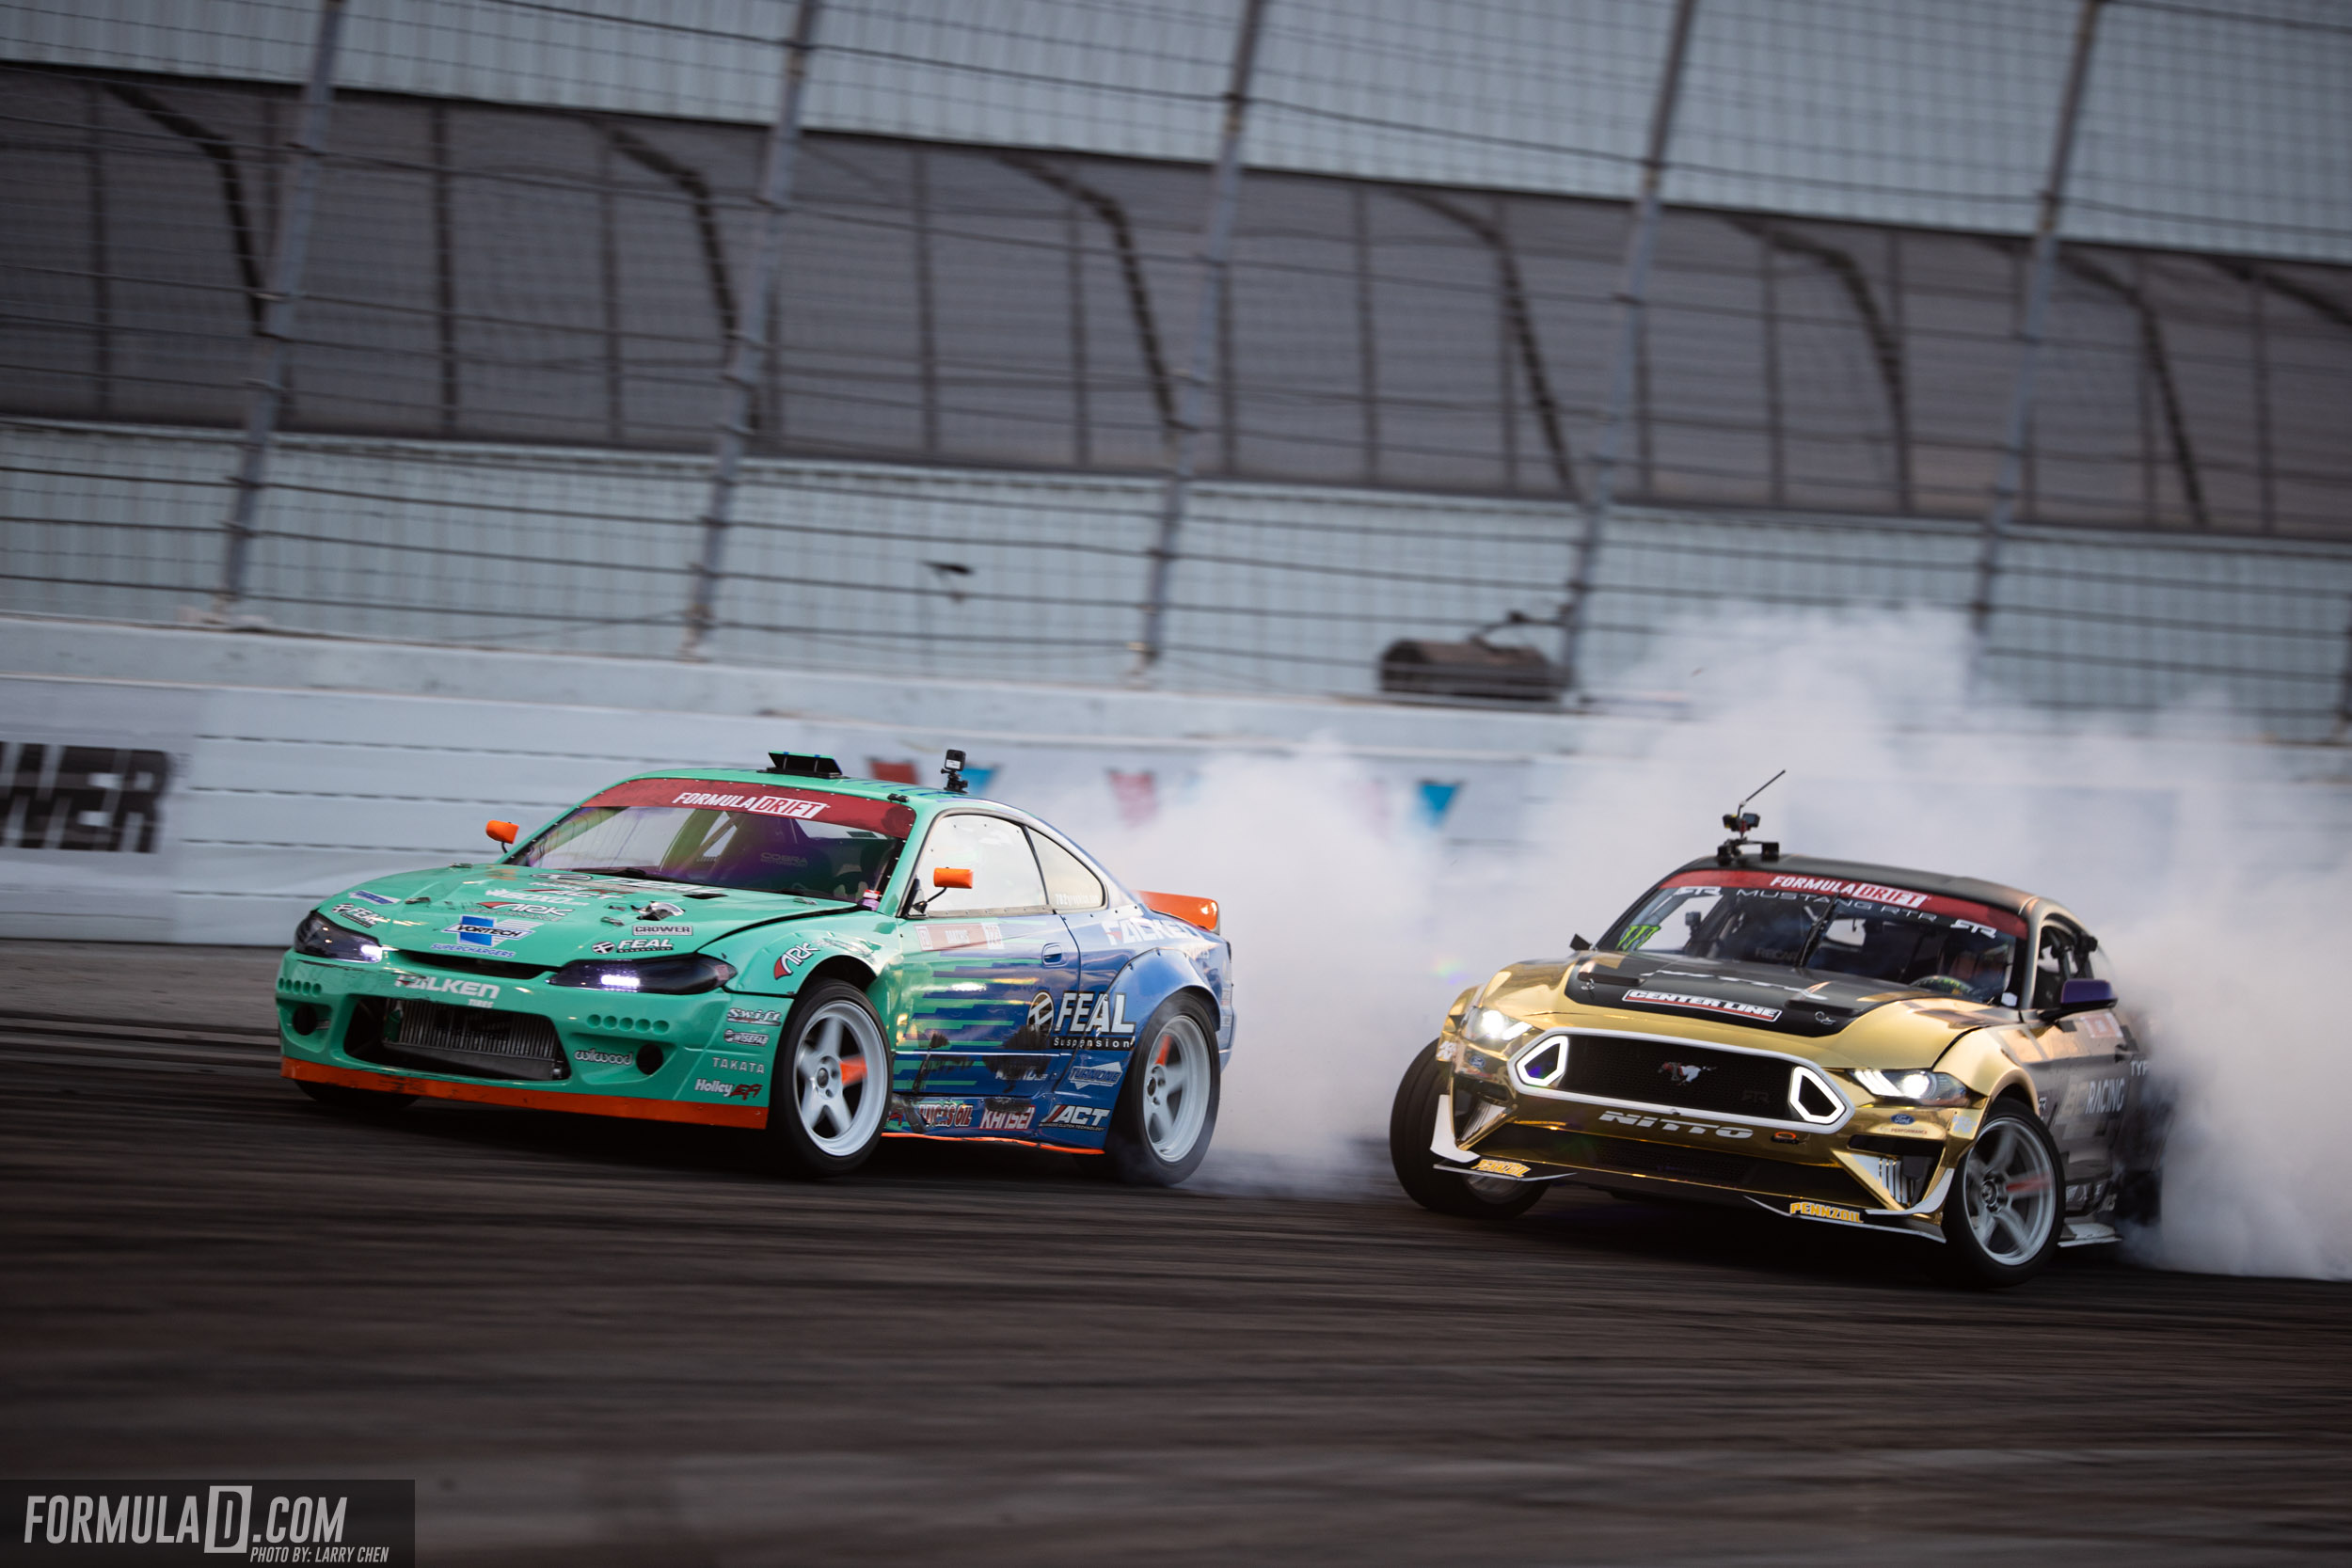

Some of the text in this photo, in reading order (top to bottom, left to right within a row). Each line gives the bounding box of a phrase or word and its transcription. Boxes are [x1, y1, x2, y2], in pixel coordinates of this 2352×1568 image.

[1736, 889, 1937, 923] MUSTANG RTR
[457, 925, 523, 938] VORTECH
[431, 943, 516, 958] SUPERCHARGERS
[617, 939, 674, 949] FEAL
[394, 974, 501, 999] FALKEN
[1054, 991, 1136, 1033] FEAL
[1629, 990, 1780, 1017] CENTER LINE
[727, 1008, 782, 1022] Swift
[1054, 1037, 1131, 1049] Suspension
[574, 1047, 633, 1066] wilwood
[712, 1057, 765, 1073] TAKATA
[694, 1078, 734, 1097] Holley
[2085, 1078, 2125, 1114] RACING
[919, 1103, 955, 1127] LUCAS
[955, 1103, 974, 1127] OIL
[1598, 1110, 1754, 1139] NITTO
[1790, 1202, 1864, 1224] PENNZOIL
